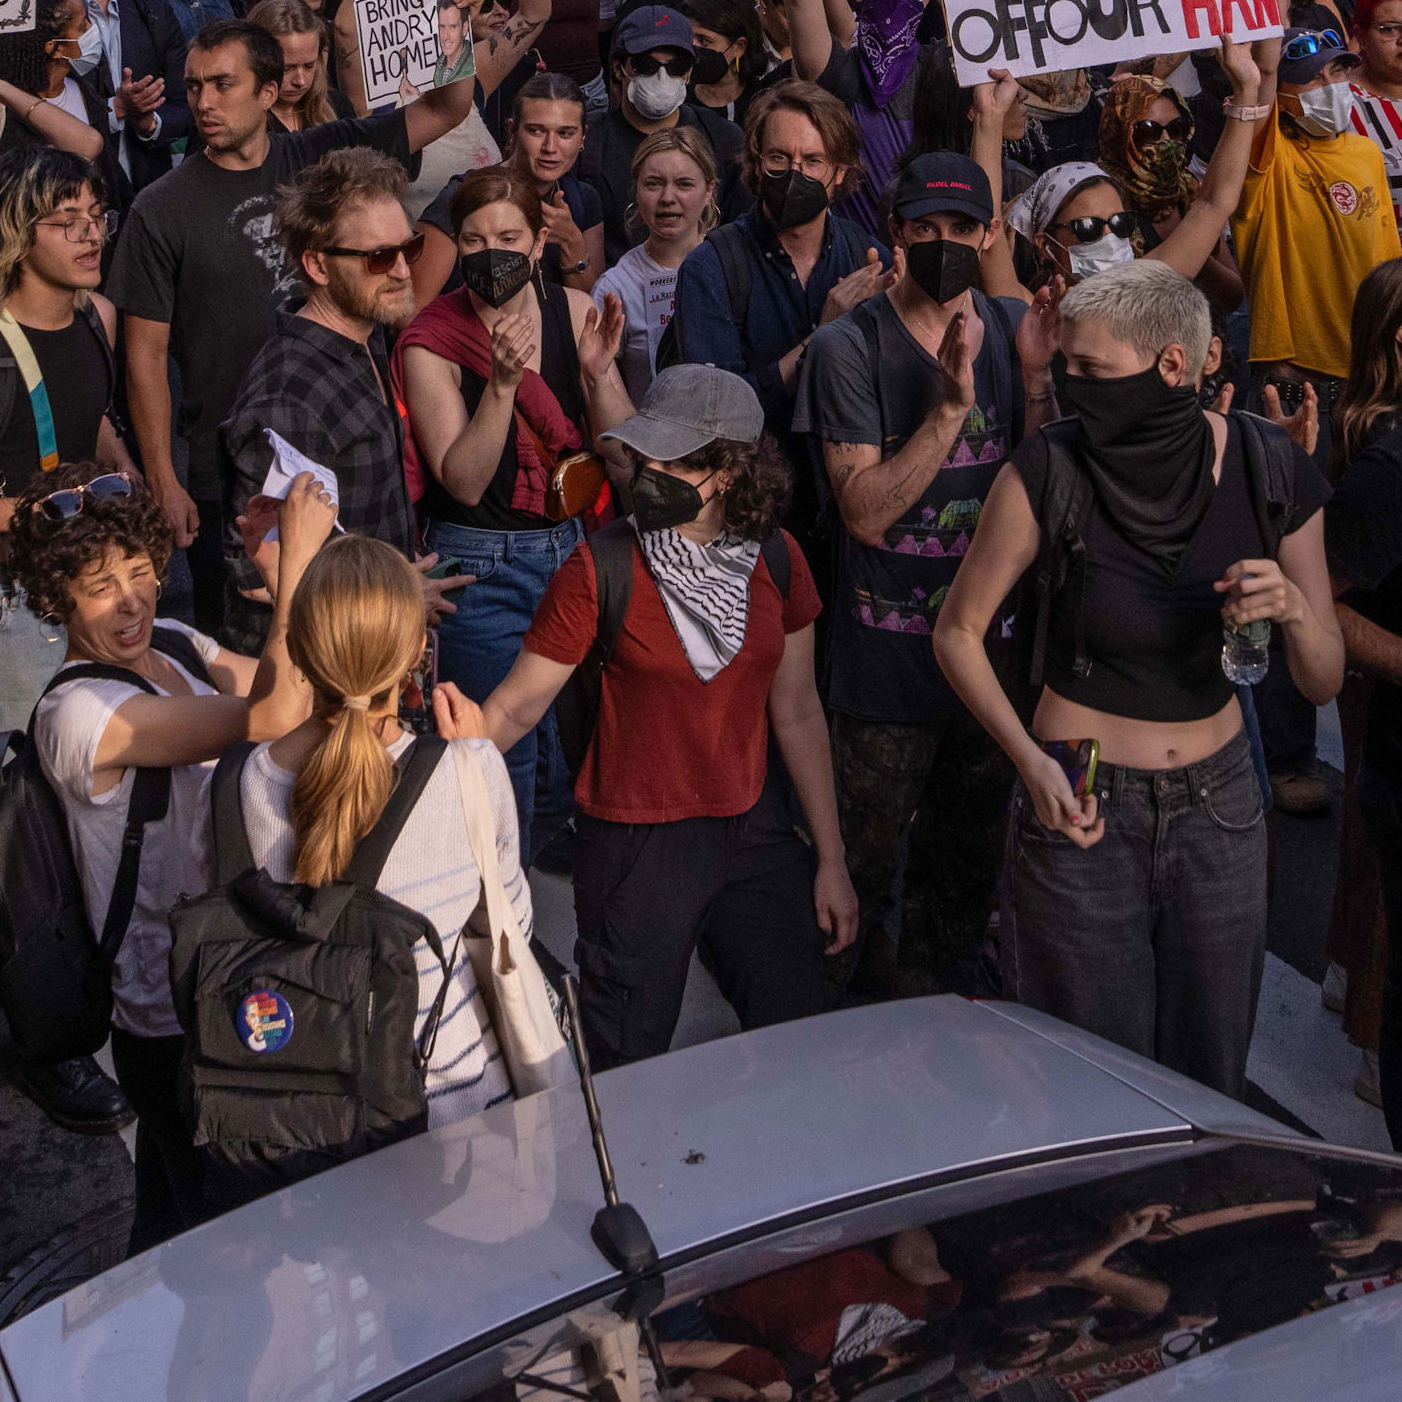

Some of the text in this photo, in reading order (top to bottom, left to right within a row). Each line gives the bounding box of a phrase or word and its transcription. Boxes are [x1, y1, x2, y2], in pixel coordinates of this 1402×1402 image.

[367, 5, 437, 57] ANDRY
[926, 181, 949, 189] REBEL
[649, 277, 677, 286] WORKERS
